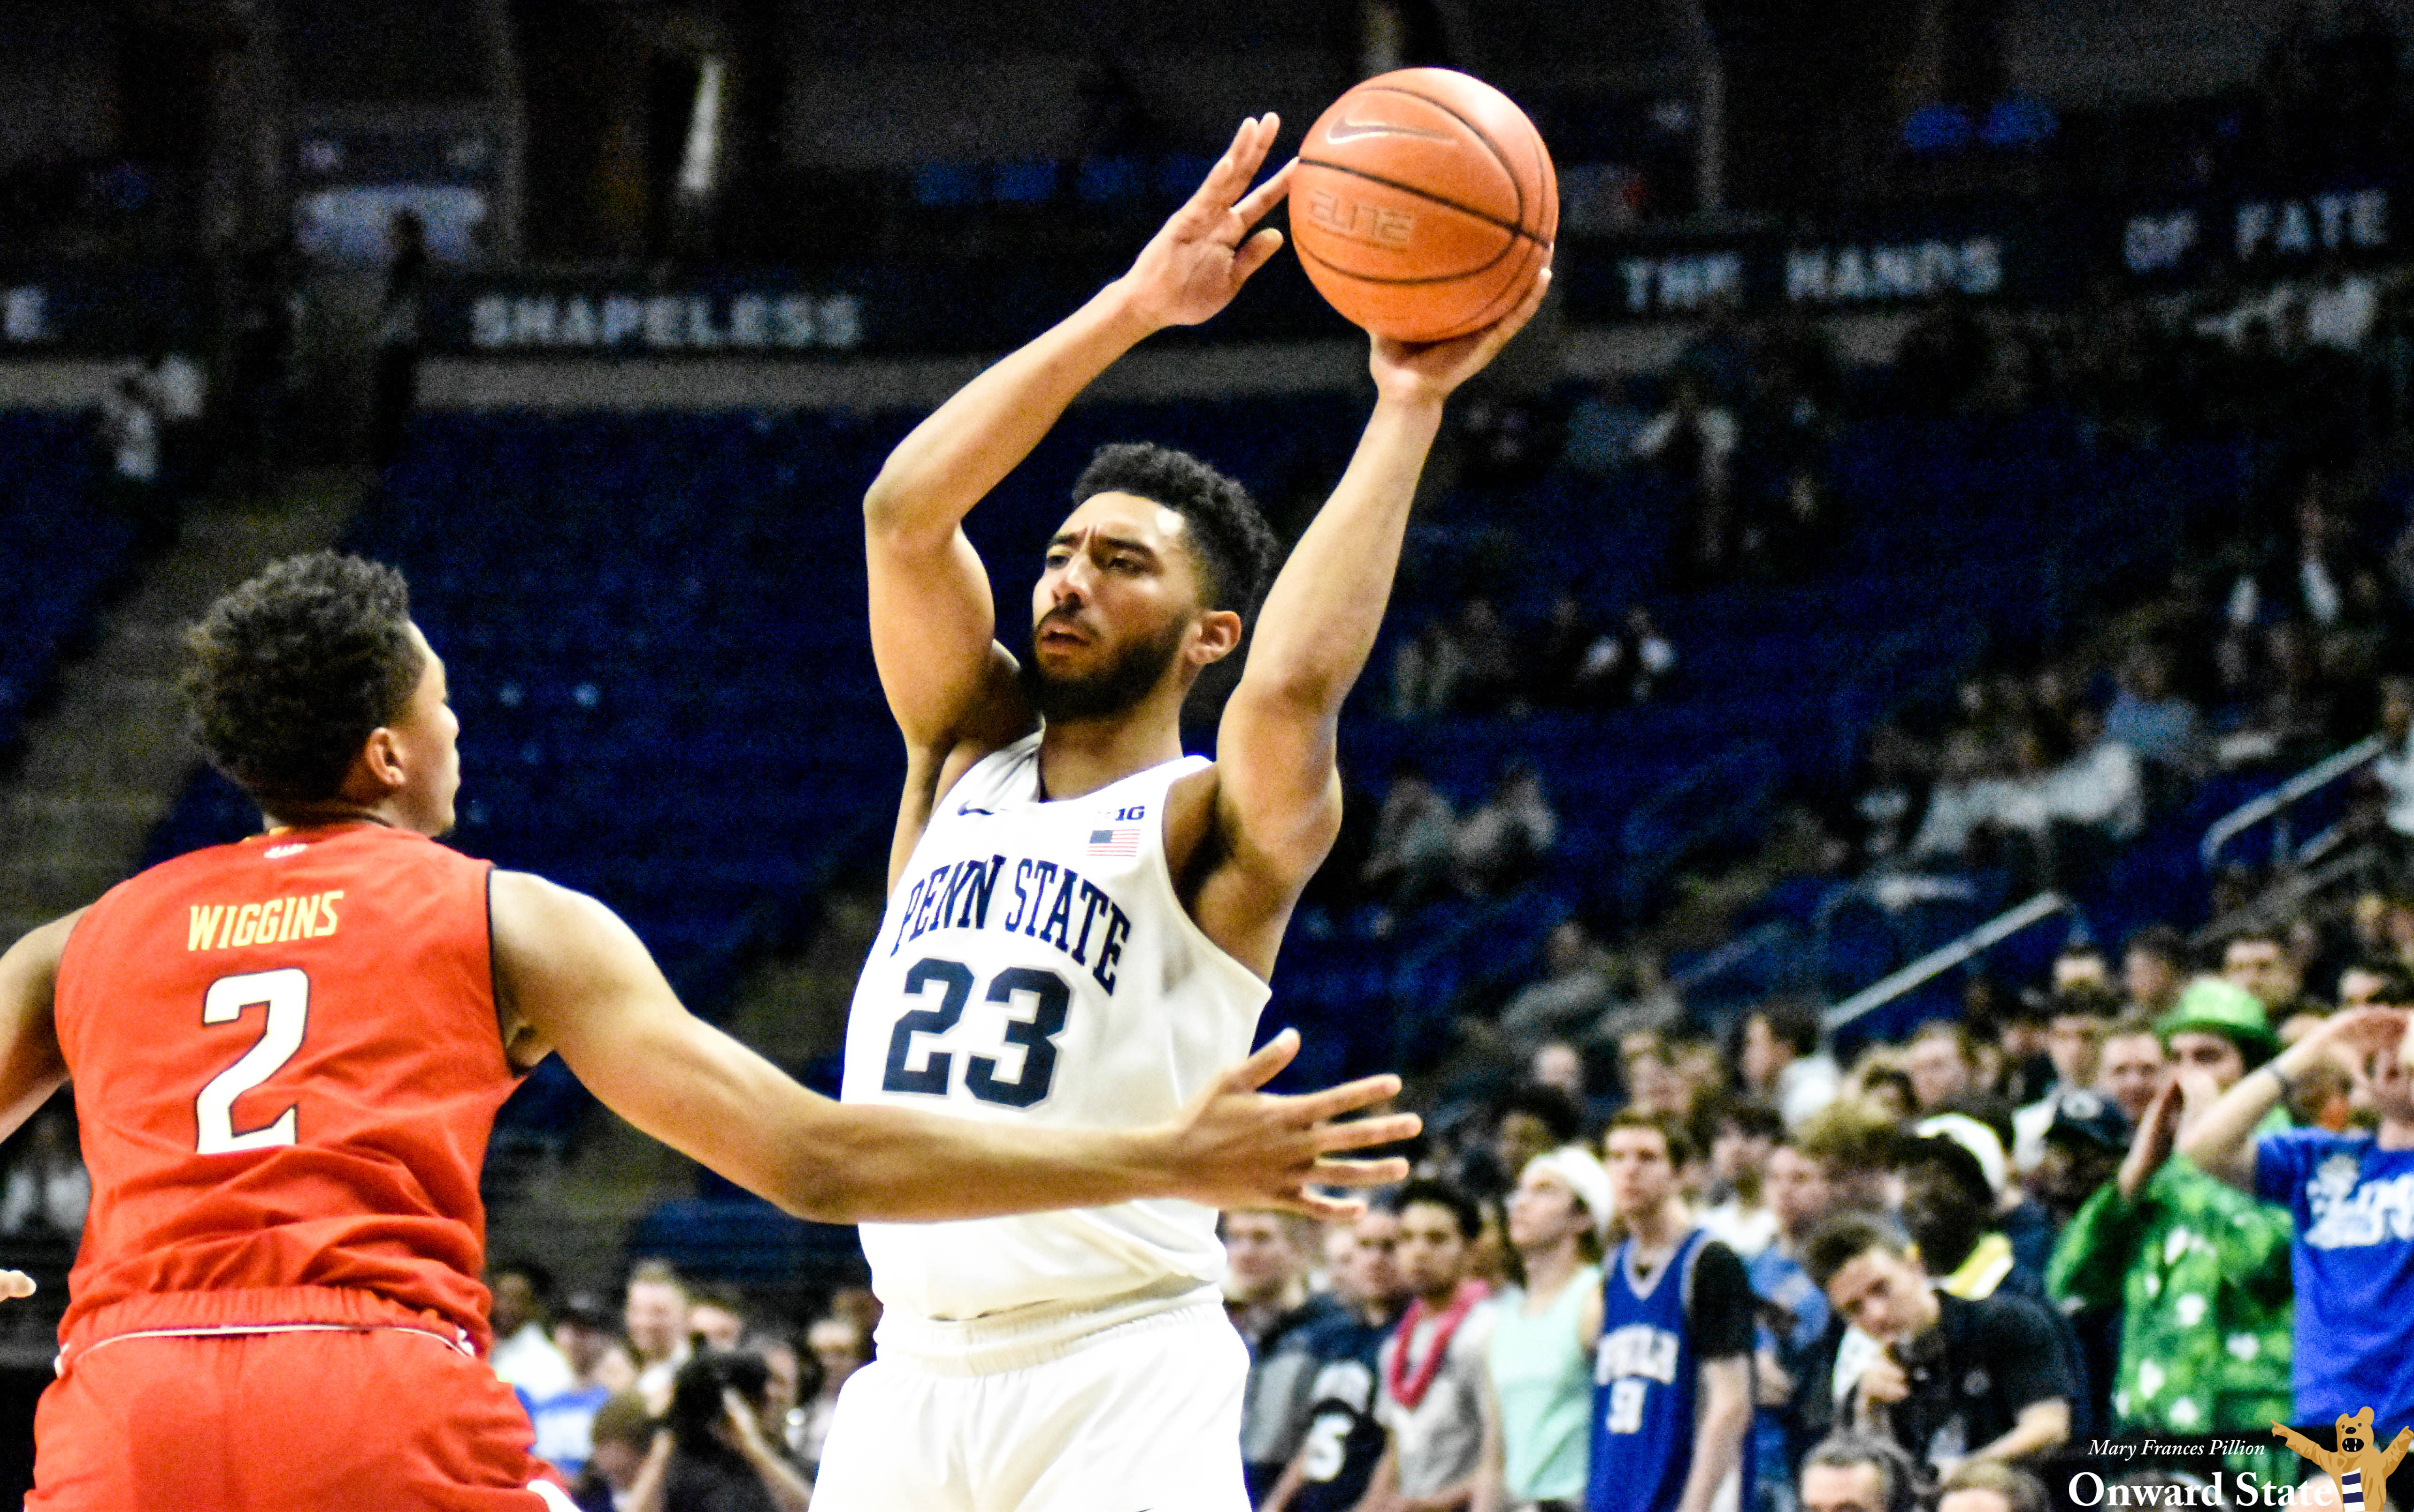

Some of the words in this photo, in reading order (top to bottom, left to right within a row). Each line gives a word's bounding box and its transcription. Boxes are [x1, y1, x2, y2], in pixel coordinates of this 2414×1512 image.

[1309, 190, 1413, 245] ELITE
[188, 890, 344, 952] WIGGINS
[890, 854, 1007, 959] PENN
[1005, 858, 1132, 997] STATE
[195, 966, 311, 1155] 2
[881, 957, 1075, 1109] 23
